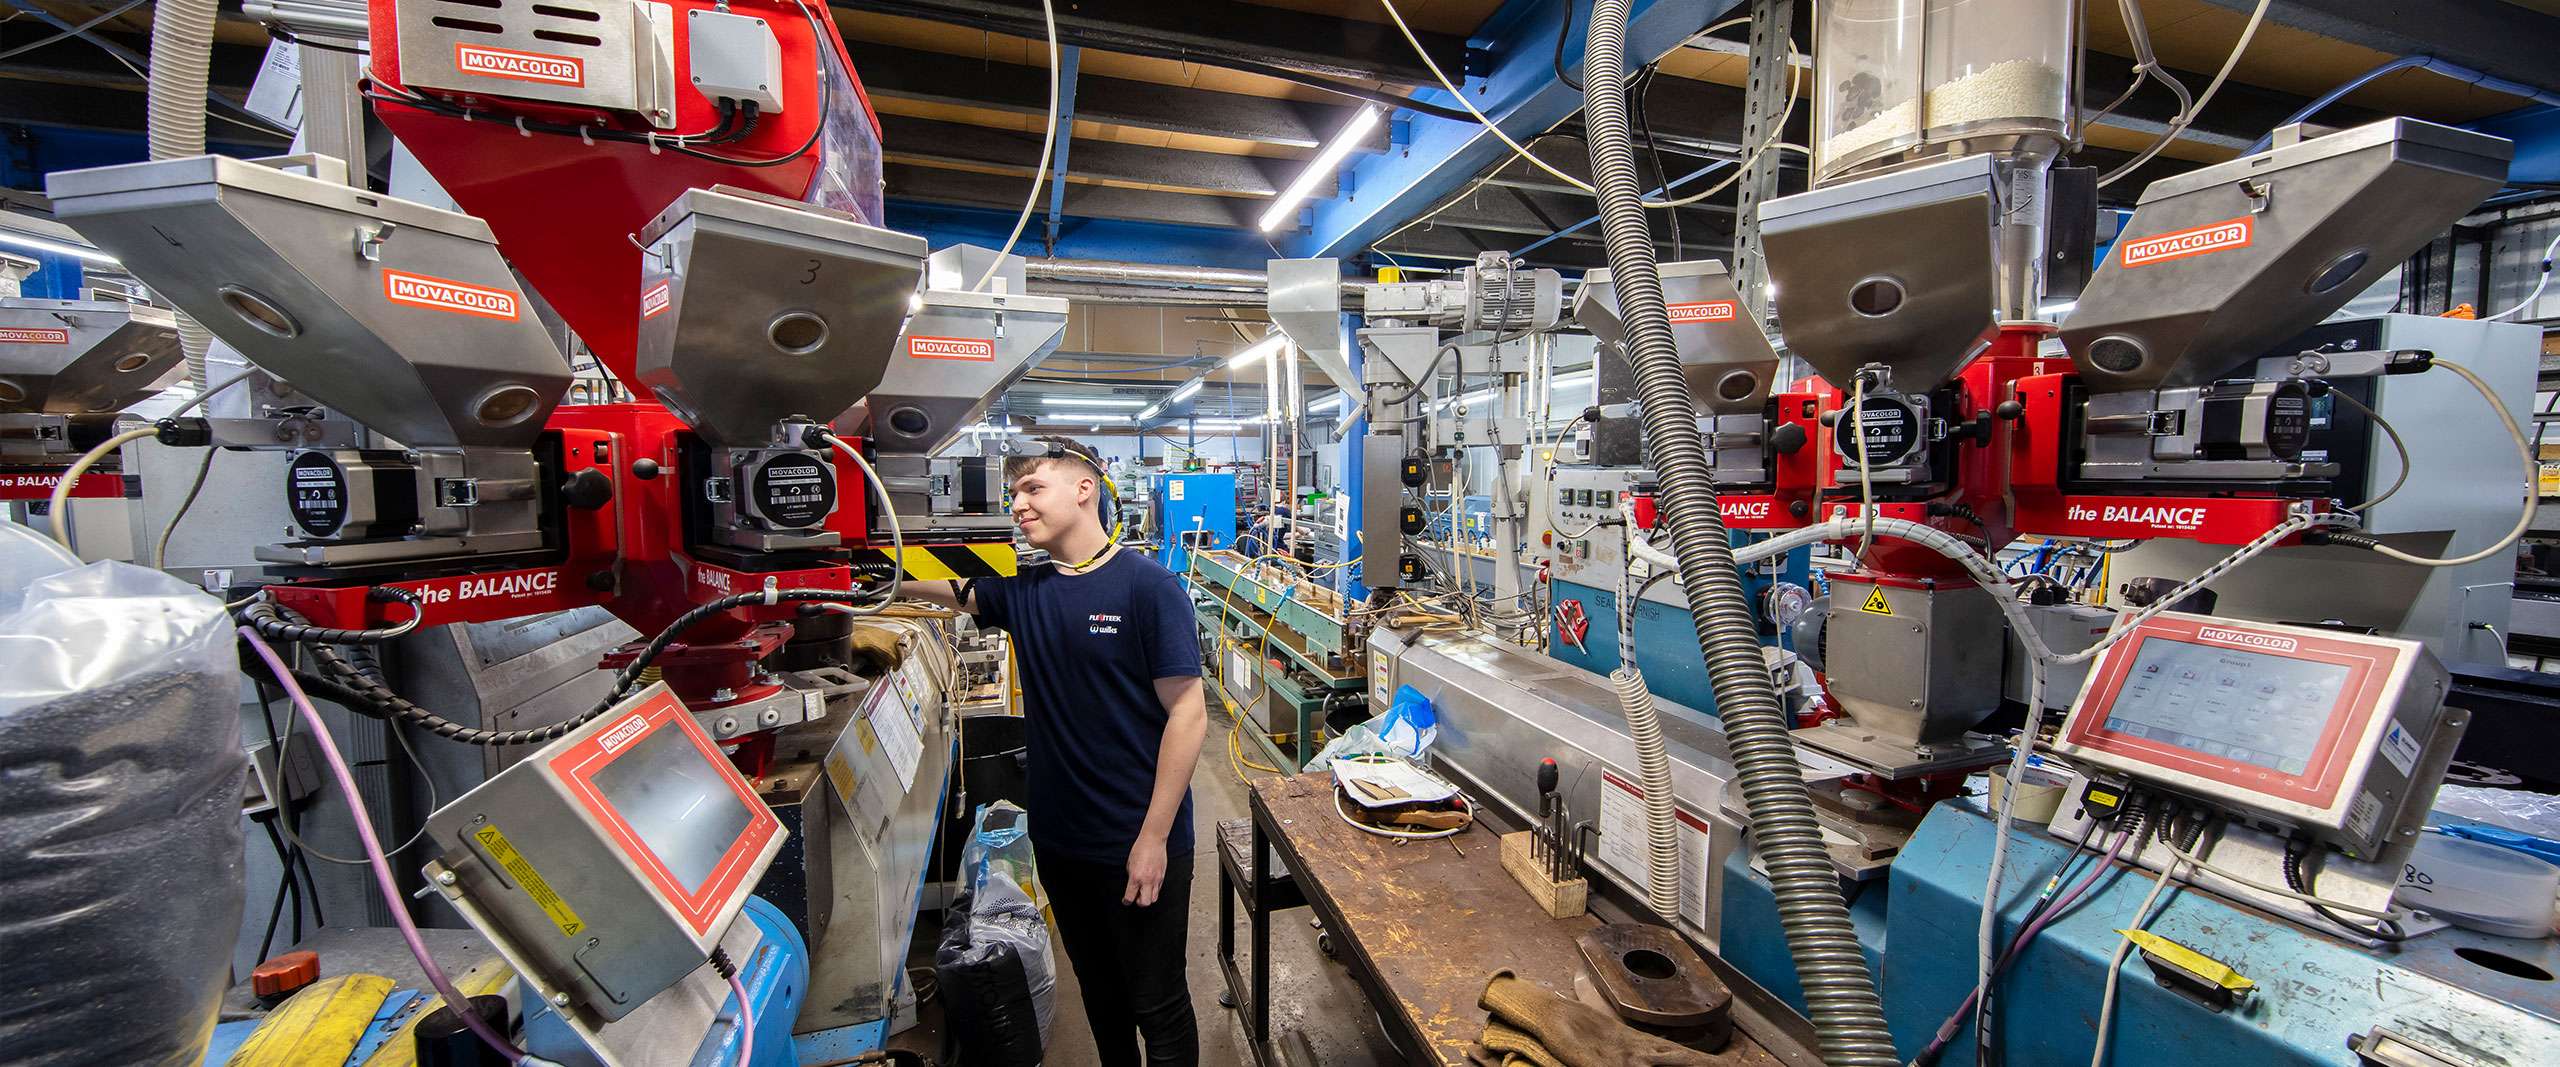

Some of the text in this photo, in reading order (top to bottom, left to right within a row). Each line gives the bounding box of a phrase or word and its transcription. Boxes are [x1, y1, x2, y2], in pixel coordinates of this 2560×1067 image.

[468, 53, 573, 78] MOVACOLOR
[2132, 228, 2240, 259] MOVACOLOR
[800, 259, 821, 285] 3
[398, 281, 509, 311] MOVACOLOR
[916, 342, 988, 355] MOVACOLOR
[1720, 502, 1770, 516] LANCE
[2067, 504, 2207, 525] the BALANCE
[458, 571, 557, 600] BALANCE
[706, 568, 731, 591] BALANCE
[2203, 630, 2292, 649] MOVACOLOR
[603, 718, 645, 749] MOVACOLOR
[2404, 863, 2434, 885] 80
